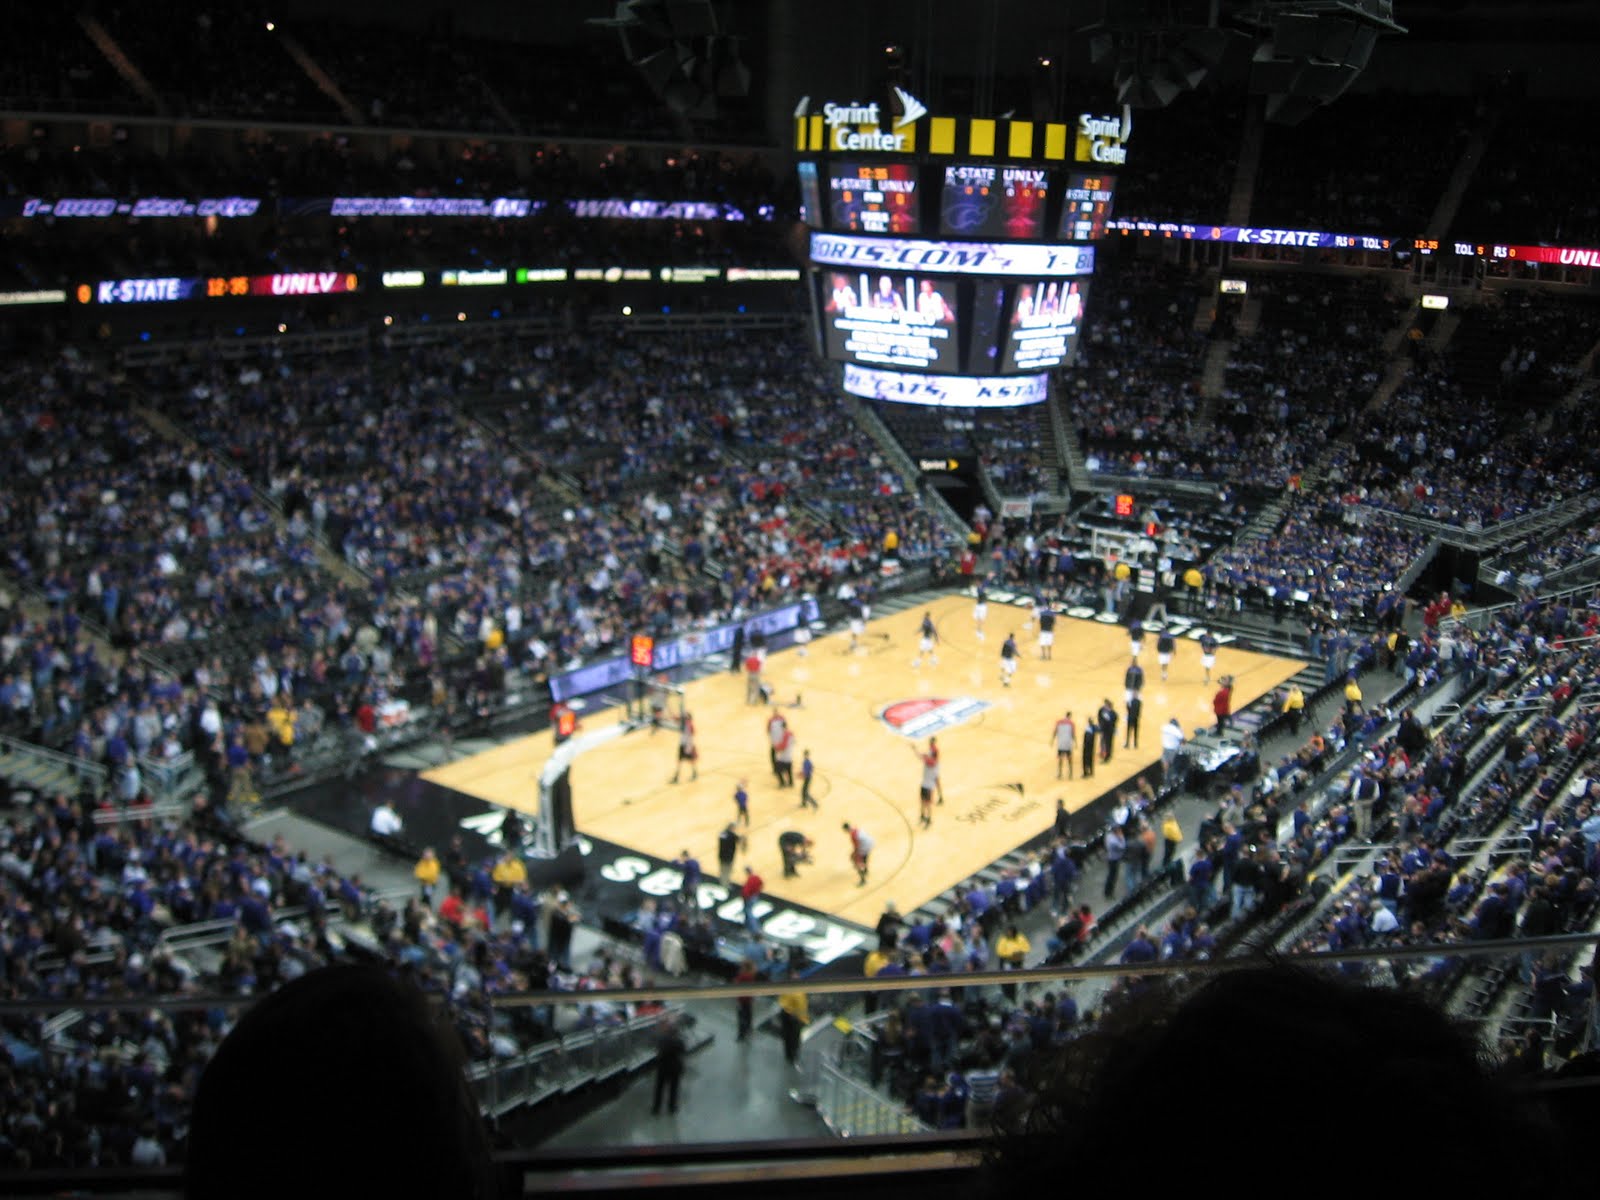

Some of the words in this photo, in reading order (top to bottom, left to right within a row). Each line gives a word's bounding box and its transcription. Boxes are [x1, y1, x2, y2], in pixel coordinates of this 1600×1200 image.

[823, 102, 880, 125] Sprint
[1079, 113, 1121, 139] Sprint
[835, 127, 905, 151] Center
[945, 167, 996, 180] K-STATE
[1002, 169, 1045, 182] UNLV
[877, 180, 915, 193] UNLV
[1237, 228, 1321, 247] K-STATE
[1414, 239, 1439, 250] 12:35
[78, 284, 91, 304] 0
[98, 278, 180, 303] K-STATE
[271, 271, 337, 295] UNLV
